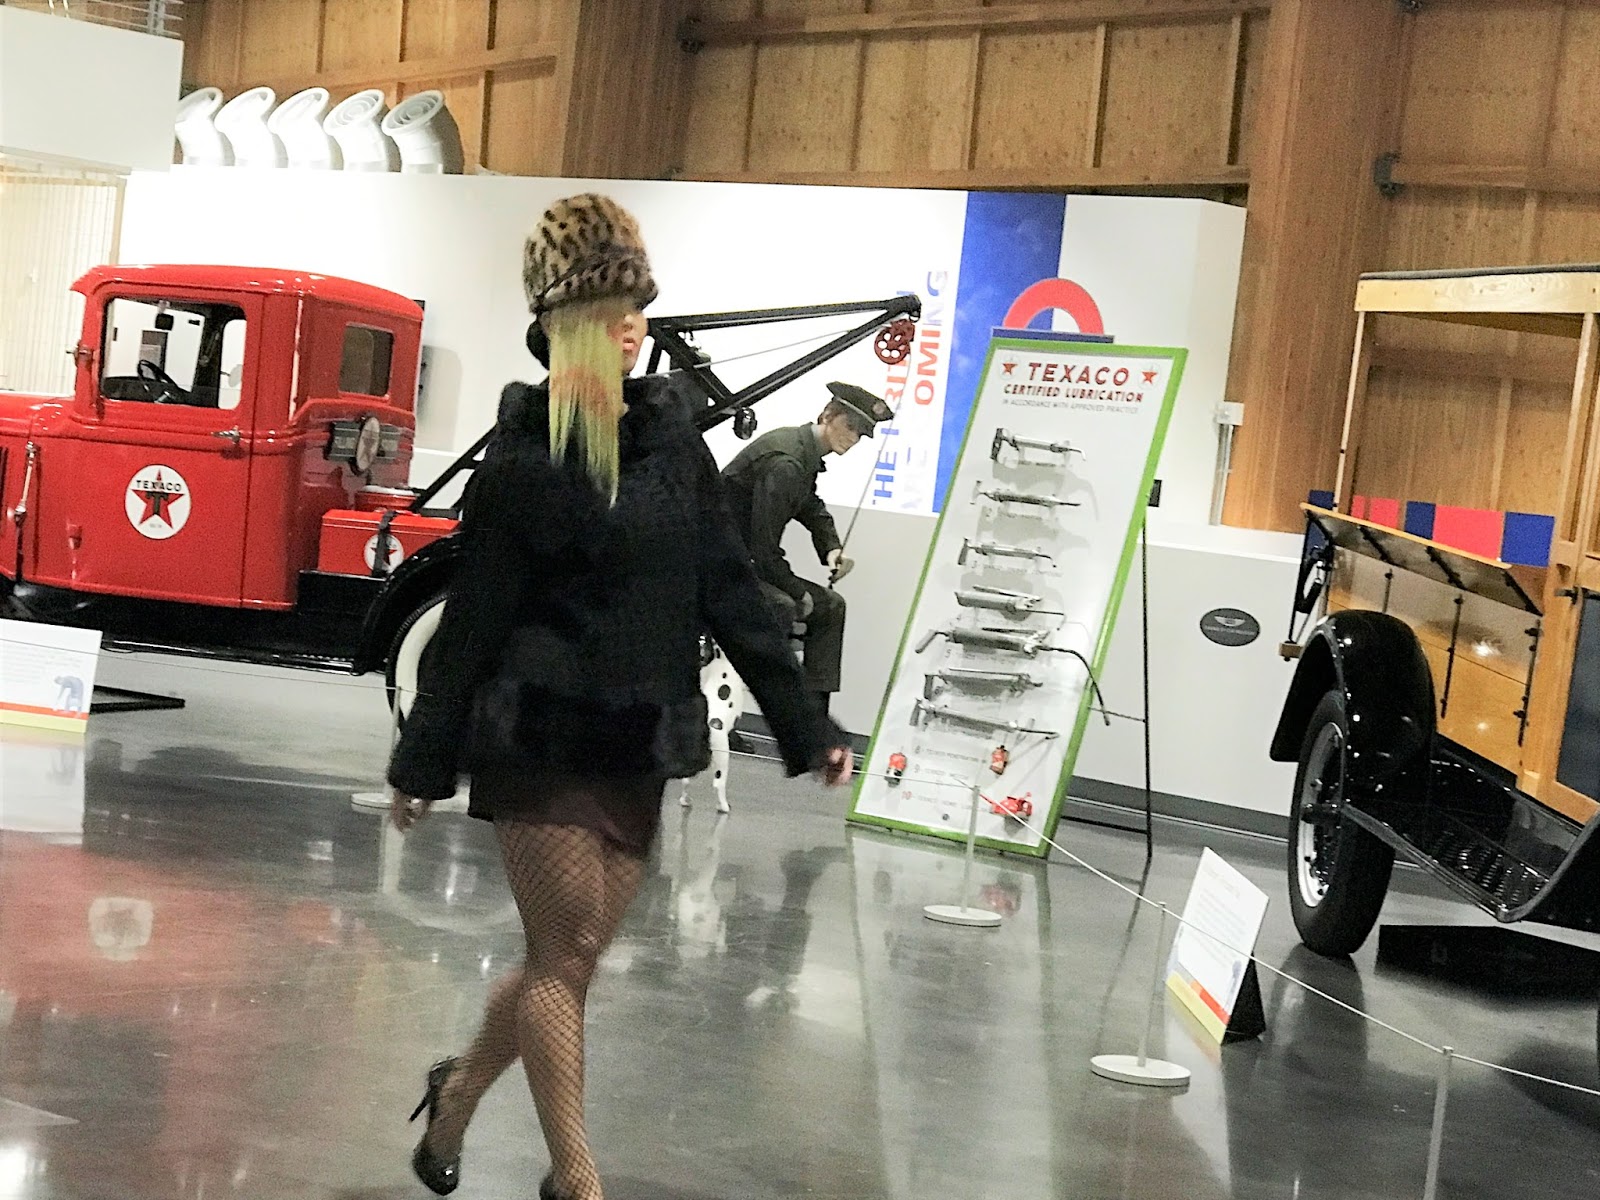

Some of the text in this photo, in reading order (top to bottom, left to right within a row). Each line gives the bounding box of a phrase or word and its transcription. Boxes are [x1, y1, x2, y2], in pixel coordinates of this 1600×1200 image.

[913, 271, 948, 406] OMING
[1028, 362, 1130, 386] TEXACO
[1003, 383, 1144, 402] CERTIFIED LUBRICATION
[136, 480, 182, 492] TEXACO
[872, 450, 897, 505] HE
